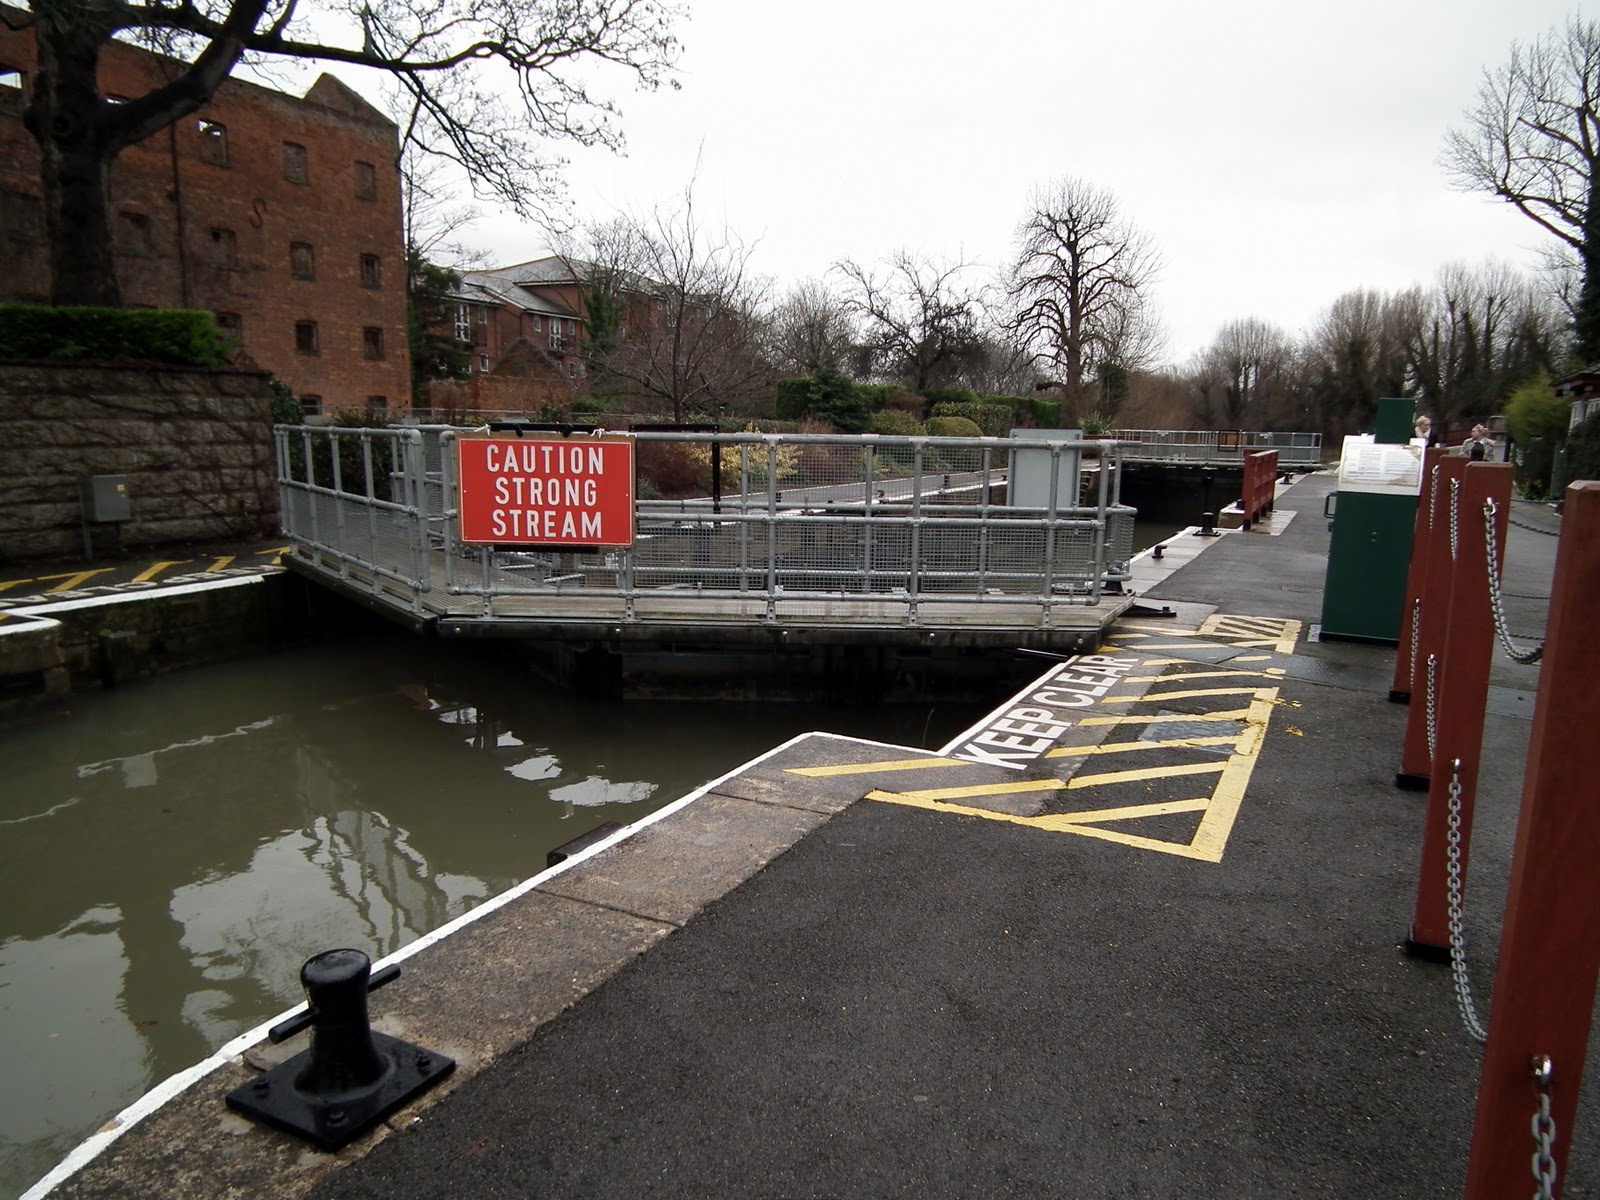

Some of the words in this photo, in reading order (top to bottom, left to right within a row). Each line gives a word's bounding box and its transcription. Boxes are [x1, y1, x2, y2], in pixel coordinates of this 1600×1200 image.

[486, 444, 604, 475] CAUTION
[495, 477, 597, 506] STRONG
[492, 509, 602, 539] STREAM
[952, 707, 1072, 771] KEEP
[1033, 655, 1139, 707] CLEAR
